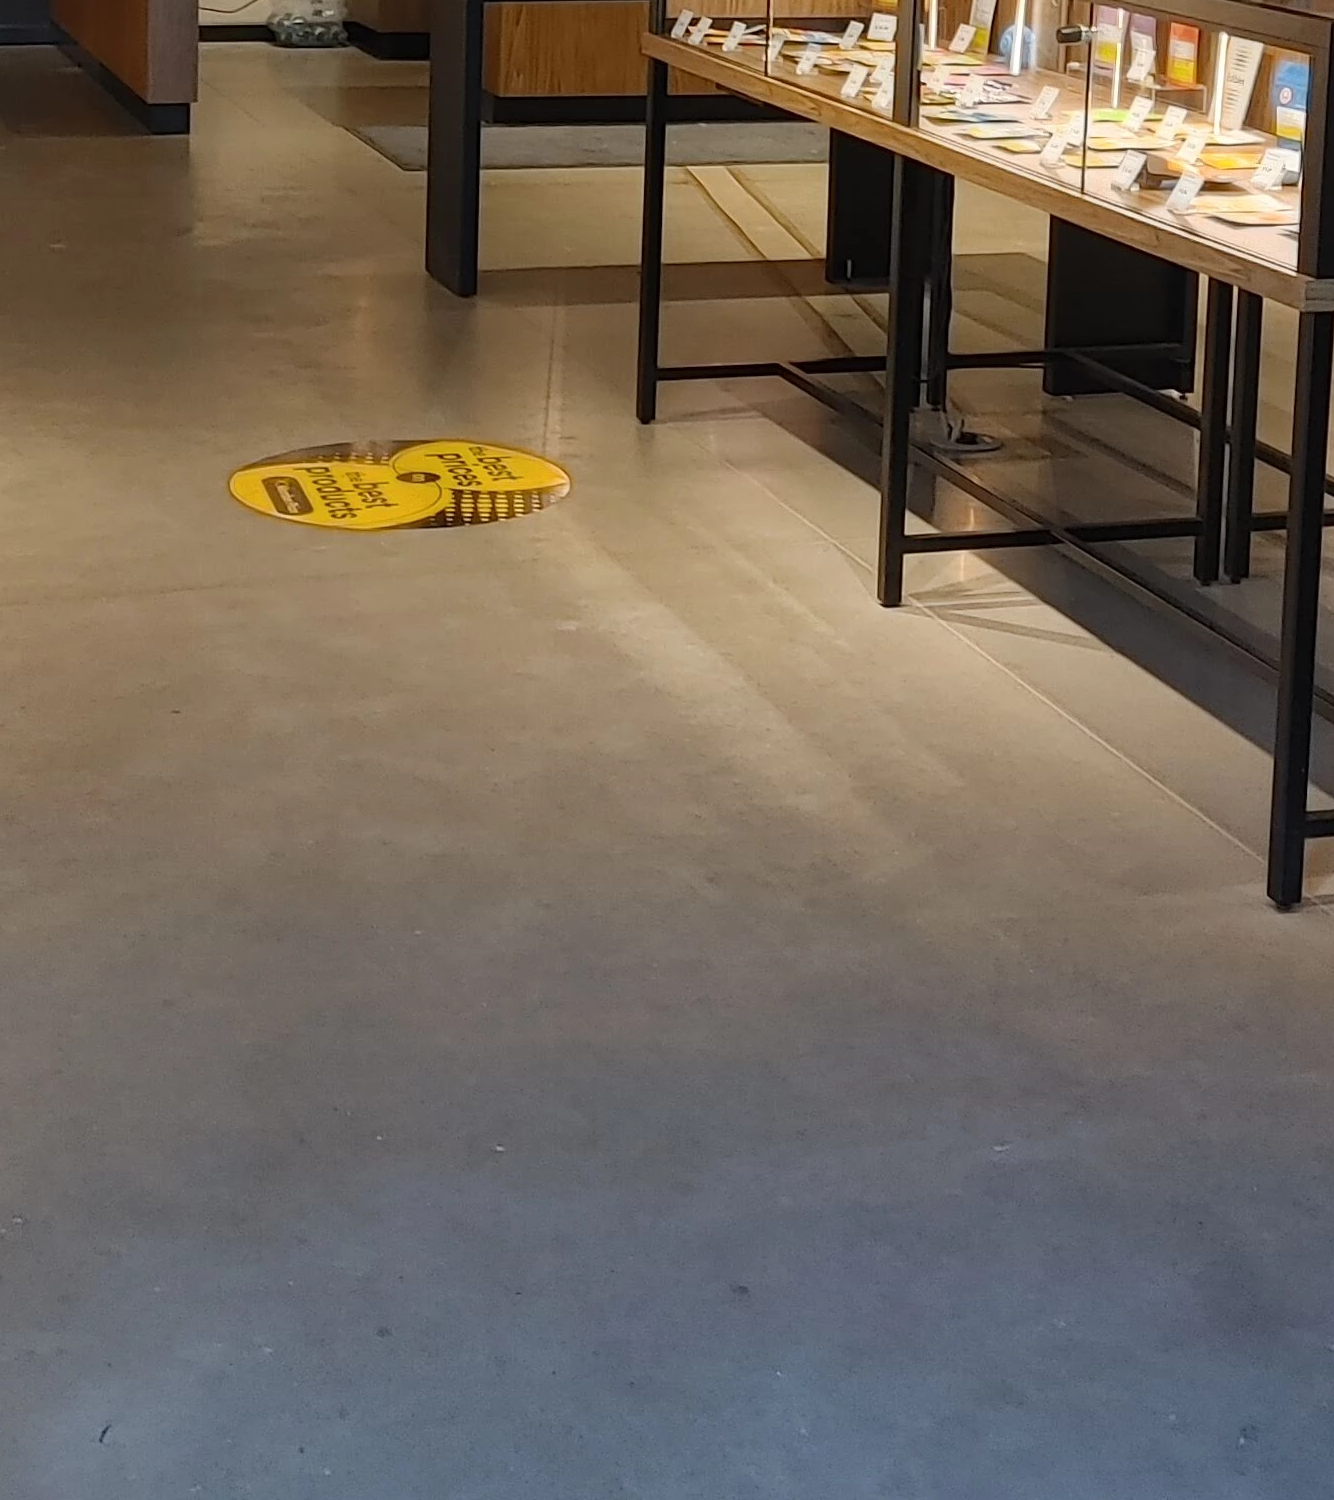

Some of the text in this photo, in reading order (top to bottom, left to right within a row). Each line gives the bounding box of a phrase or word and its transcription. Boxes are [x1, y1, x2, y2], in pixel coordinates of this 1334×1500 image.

[424, 453, 483, 487] prices
[476, 456, 524, 482] best
[293, 466, 361, 520] products
[353, 482, 399, 509] best
